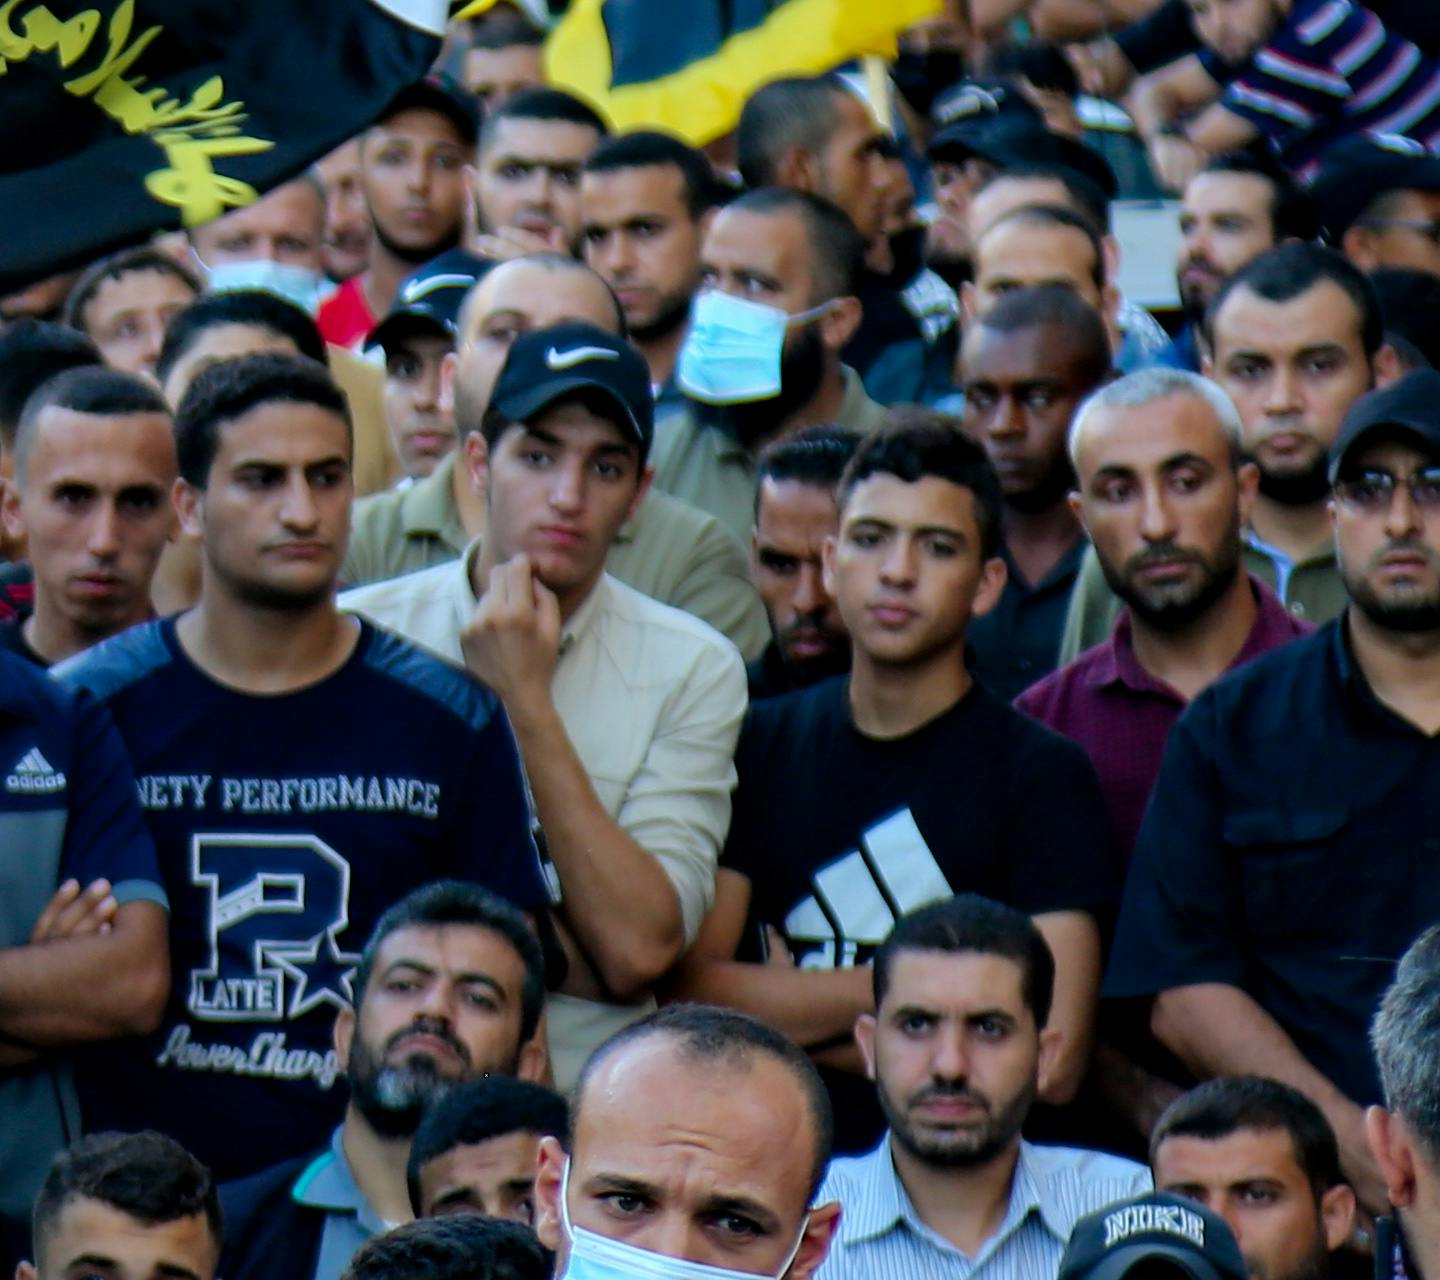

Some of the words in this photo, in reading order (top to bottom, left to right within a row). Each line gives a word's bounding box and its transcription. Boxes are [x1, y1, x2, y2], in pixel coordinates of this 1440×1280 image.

[5, 772, 67, 792] adidas
[223, 774, 442, 818] PERFORMANCE
[196, 979, 275, 1010] LATTE
[1103, 1204, 1206, 1249] NIKE
